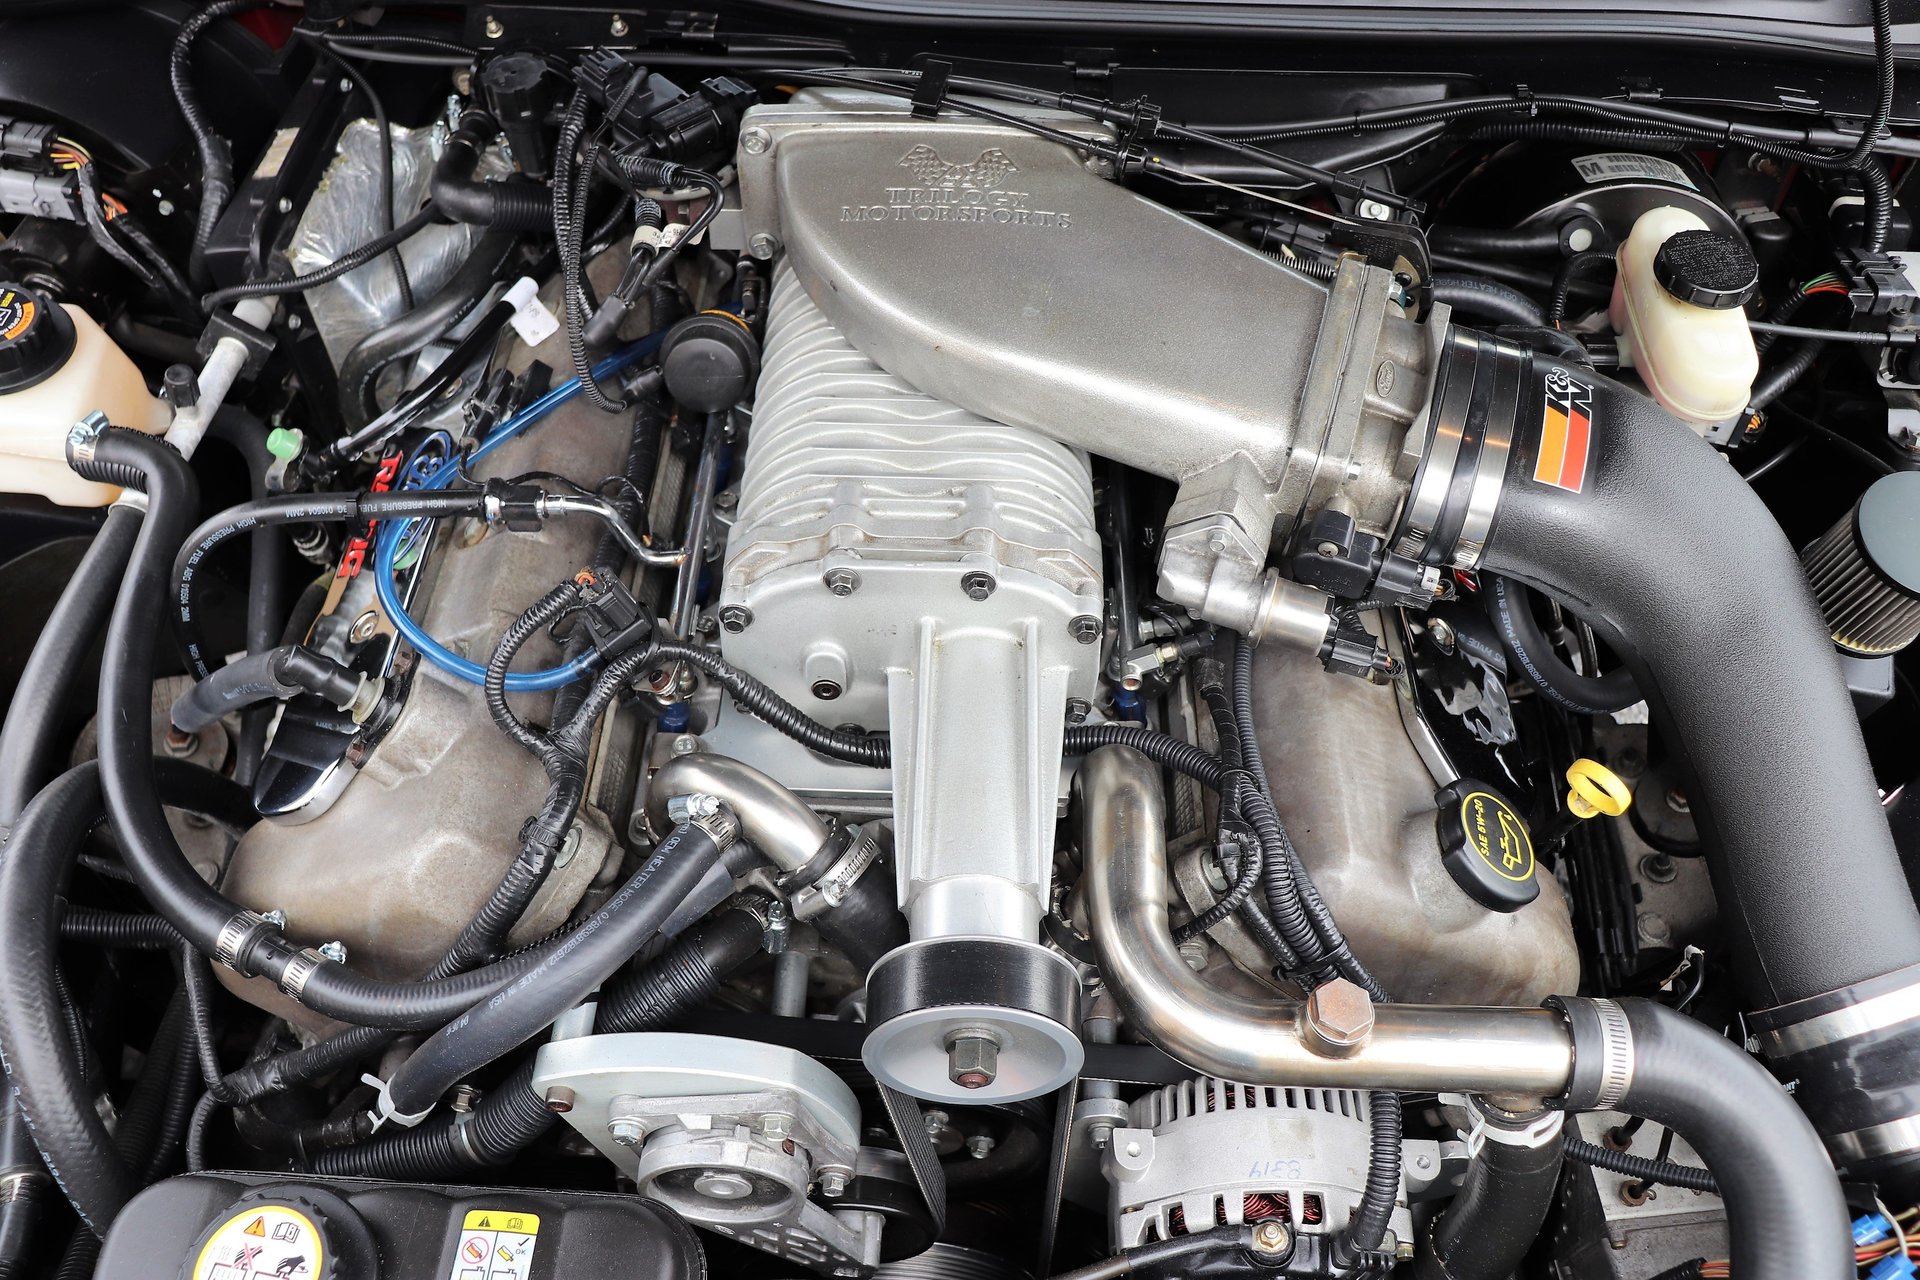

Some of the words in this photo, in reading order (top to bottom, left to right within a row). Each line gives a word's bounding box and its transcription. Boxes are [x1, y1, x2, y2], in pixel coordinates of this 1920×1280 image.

[1579, 162, 1604, 177] M
[885, 187, 1028, 207] TRILOGY
[840, 205, 1073, 229] MOTORSPORTS
[1461, 280, 1497, 293] HEATER
[1500, 288, 1517, 301] OEM
[359, 503, 378, 513] FUEL
[382, 501, 423, 511] PRESSURE
[427, 499, 447, 509] HIGH
[285, 508, 305, 518] 2MM
[236, 516, 257, 529] HIGH
[200, 524, 236, 550] PRESSURE
[188, 549, 204, 565] FUEL
[1496, 577, 1505, 596] USA
[1498, 598, 1508, 610] IN
[1500, 610, 1516, 638] MADE
[1473, 798, 1487, 834] 5W-20
[661, 836, 681, 854] OEM
[1479, 834, 1490, 857] SAE
[631, 855, 665, 889] HEATER
[608, 888, 635, 912] HOSE
[518, 965, 548, 989] MADE
[488, 990, 506, 1010] USA
[507, 986, 517, 998] IN
[515, 1248, 527, 1256] OK
